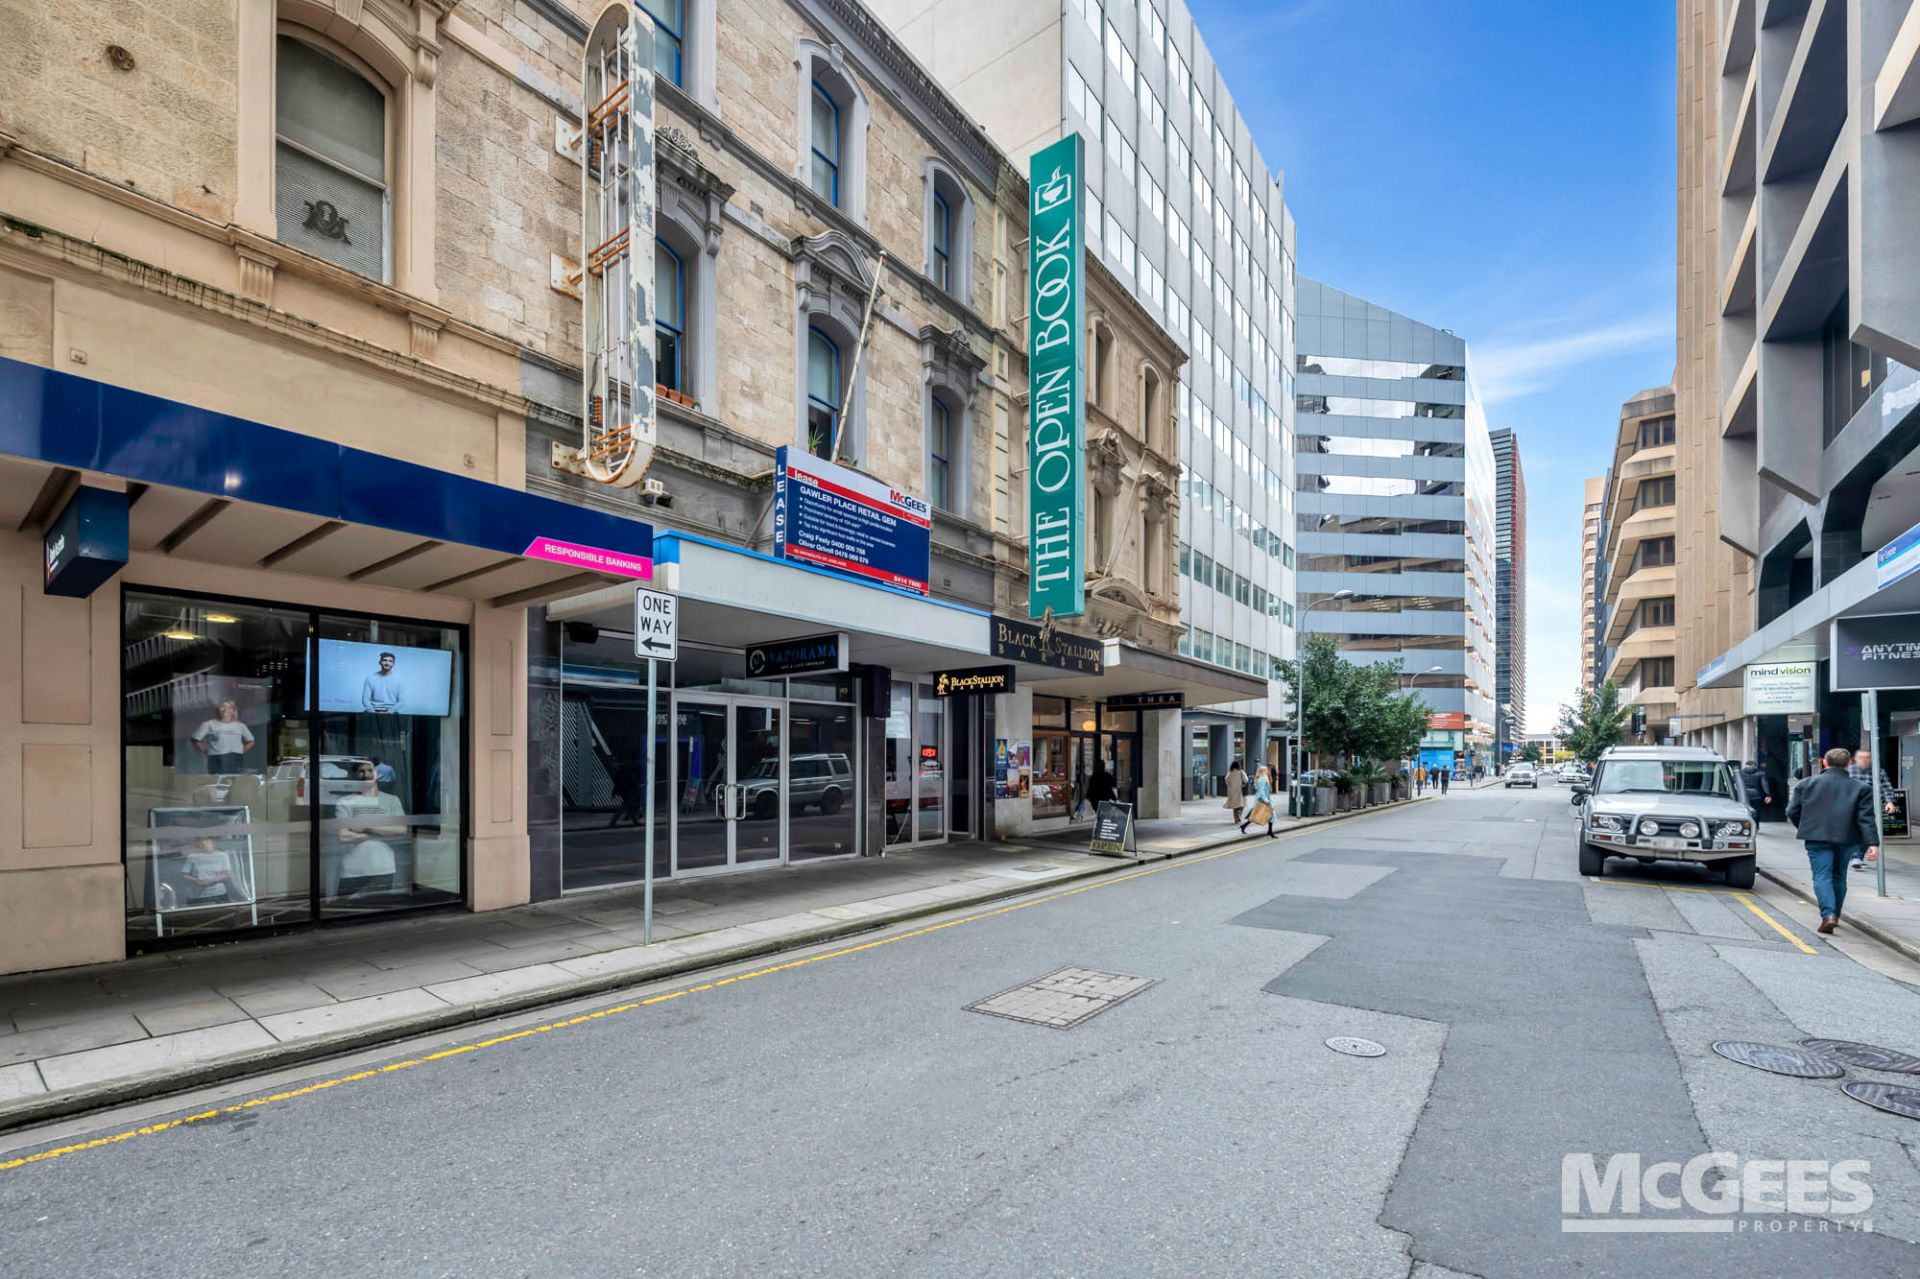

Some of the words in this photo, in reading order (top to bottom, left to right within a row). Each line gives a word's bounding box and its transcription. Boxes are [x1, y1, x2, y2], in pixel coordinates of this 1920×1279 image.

[1036, 218, 1070, 356] BOOK
[1035, 366, 1071, 492] OPEN
[794, 469, 818, 487] lease
[776, 464, 785, 543] LEASE
[800, 486, 833, 503] GAWLER
[833, 497, 857, 512] PLACE
[858, 506, 881, 521] RETAIL
[882, 516, 897, 526] GEM
[889, 488, 926, 513] McGEES
[798, 530, 814, 541] Craig
[830, 540, 844, 549] 0400
[798, 538, 815, 549] Oliver
[1036, 506, 1070, 592] THE
[544, 544, 604, 564] RESPONSIBLE
[606, 557, 642, 571] BANKING
[643, 595, 670, 615] ONE
[641, 616, 672, 635] WAY
[998, 623, 1036, 648] BLACK
[1055, 637, 1101, 662] STALLION
[1751, 668, 1778, 676] mind
